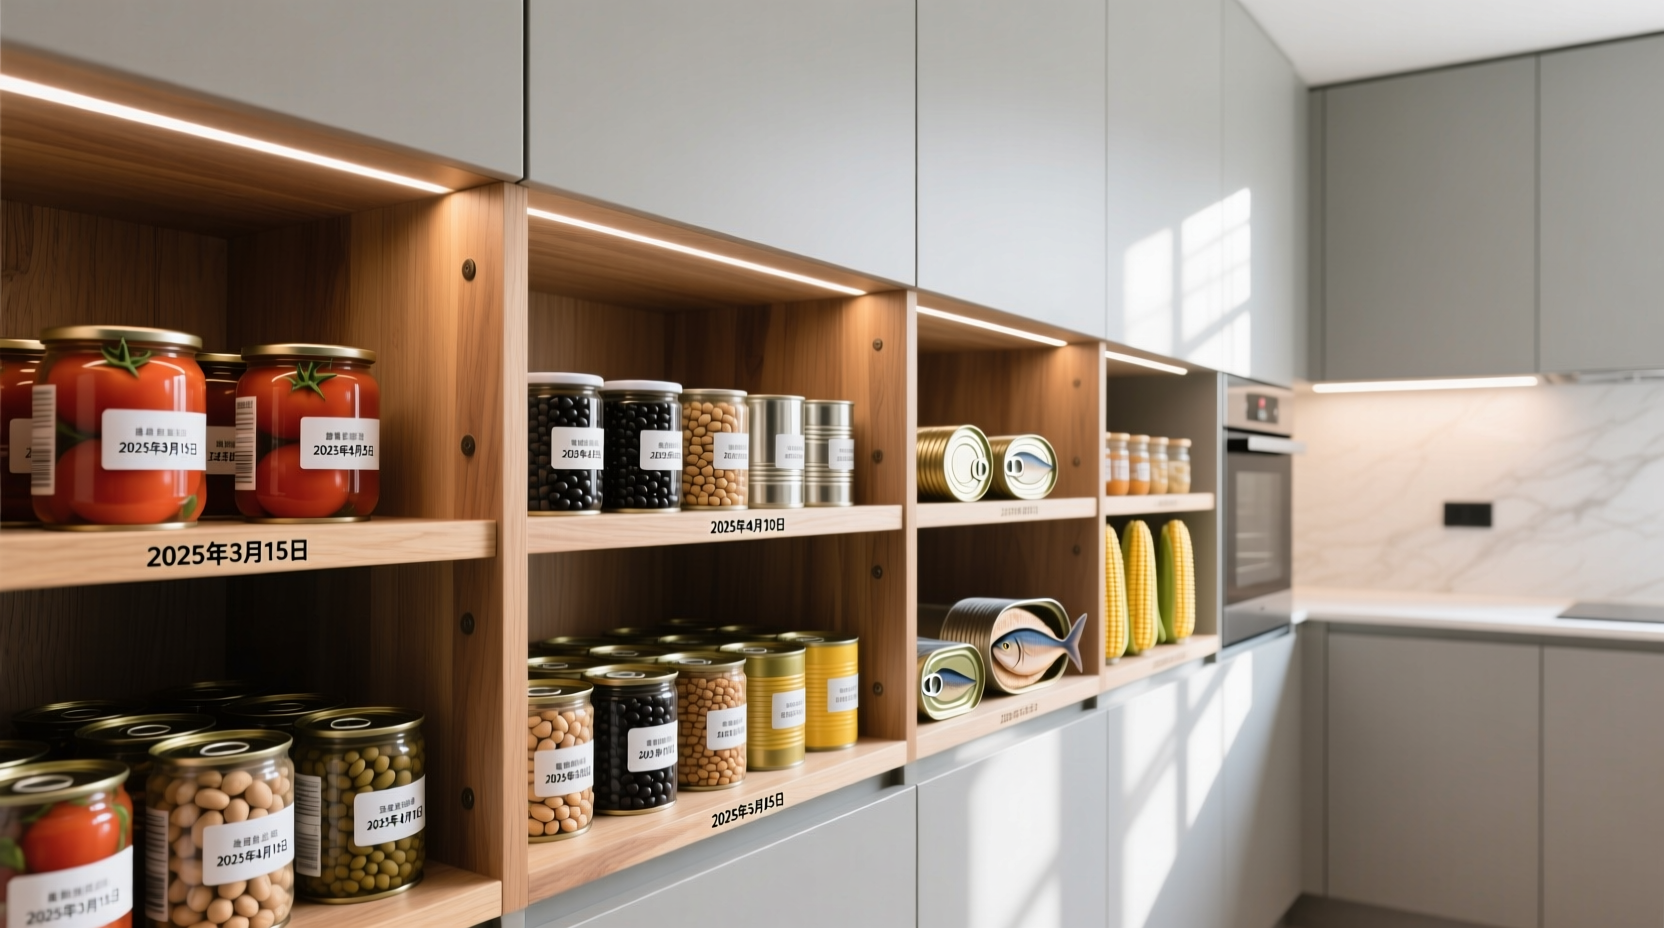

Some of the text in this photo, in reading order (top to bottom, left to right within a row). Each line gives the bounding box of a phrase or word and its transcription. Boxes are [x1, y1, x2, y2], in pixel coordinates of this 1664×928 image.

[710, 517, 785, 534] 2025年4月10日
[146, 539, 308, 567] 2025年3月15日
